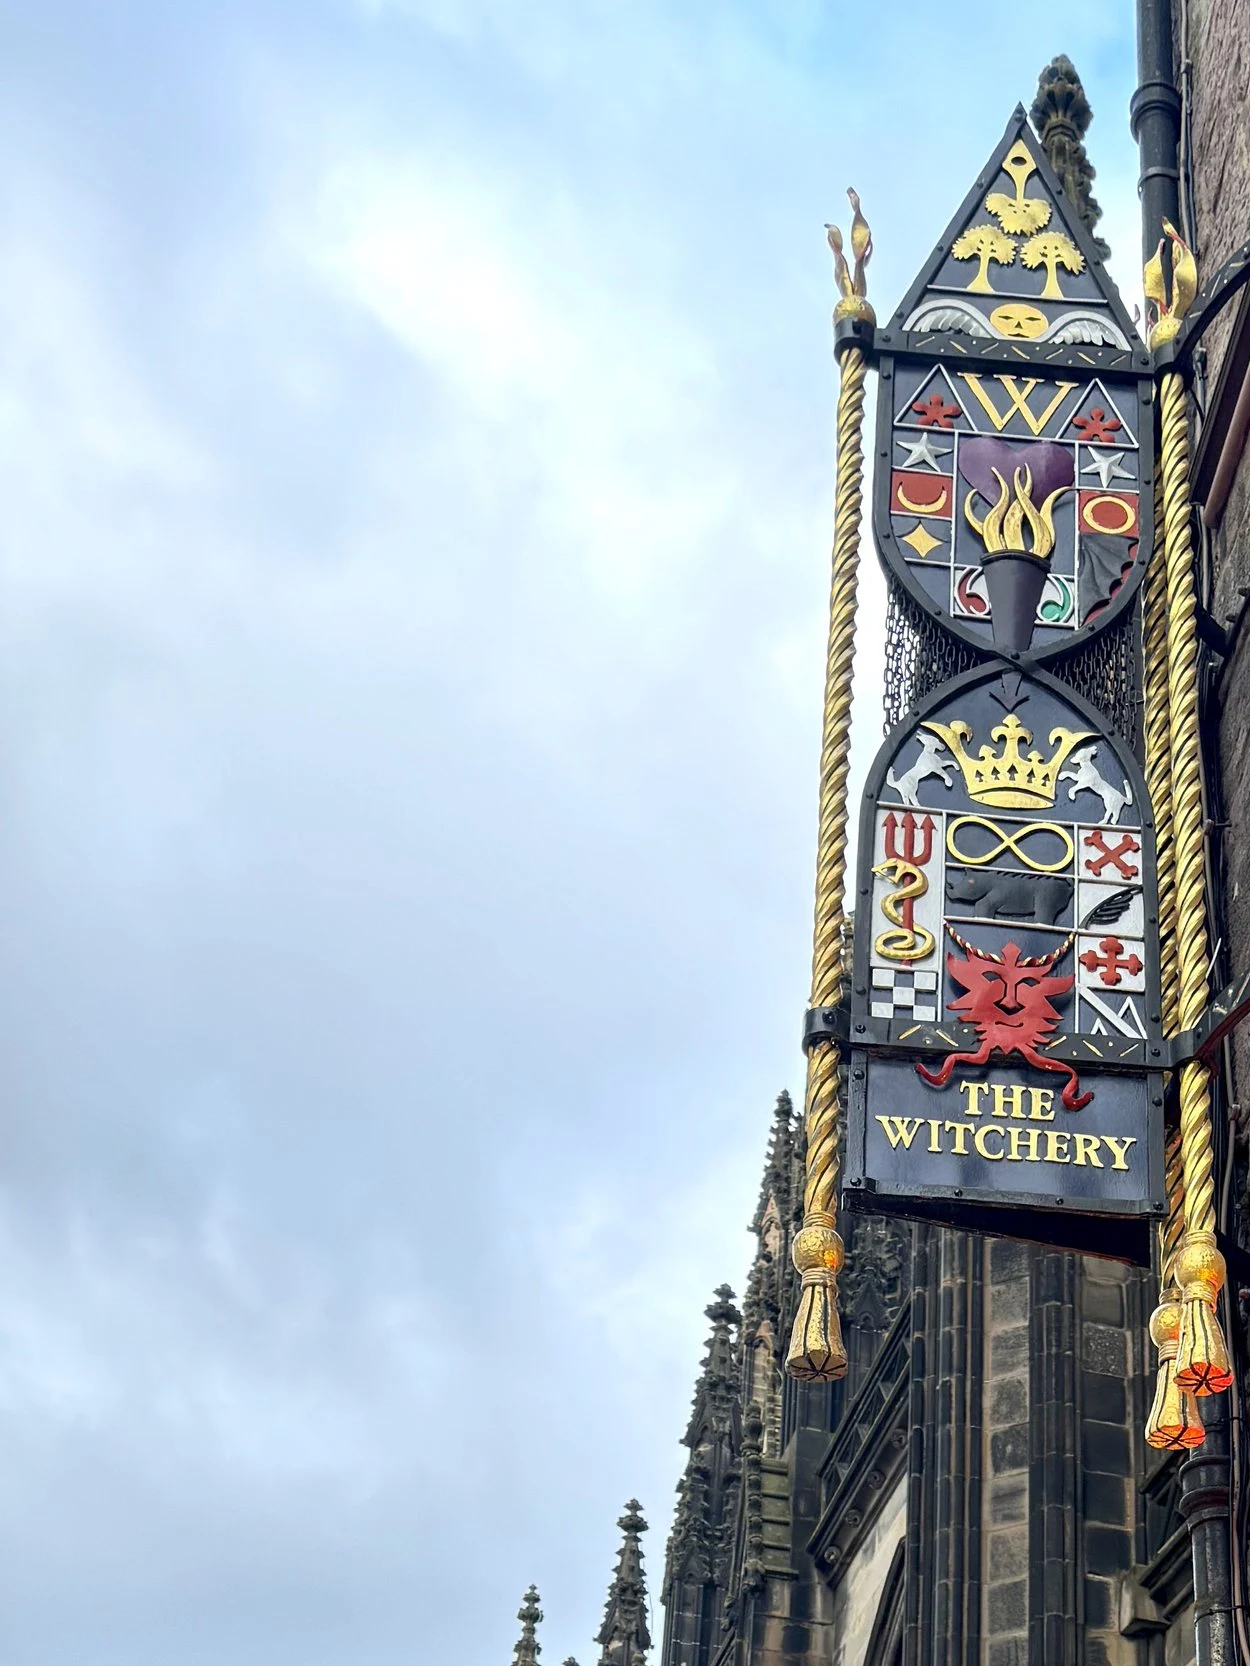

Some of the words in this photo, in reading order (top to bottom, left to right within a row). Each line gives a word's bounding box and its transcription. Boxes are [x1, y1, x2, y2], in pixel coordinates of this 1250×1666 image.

[957, 372, 1079, 436] W
[960, 1080, 1055, 1121] THE
[875, 1115, 1137, 1170] WITCHERY
